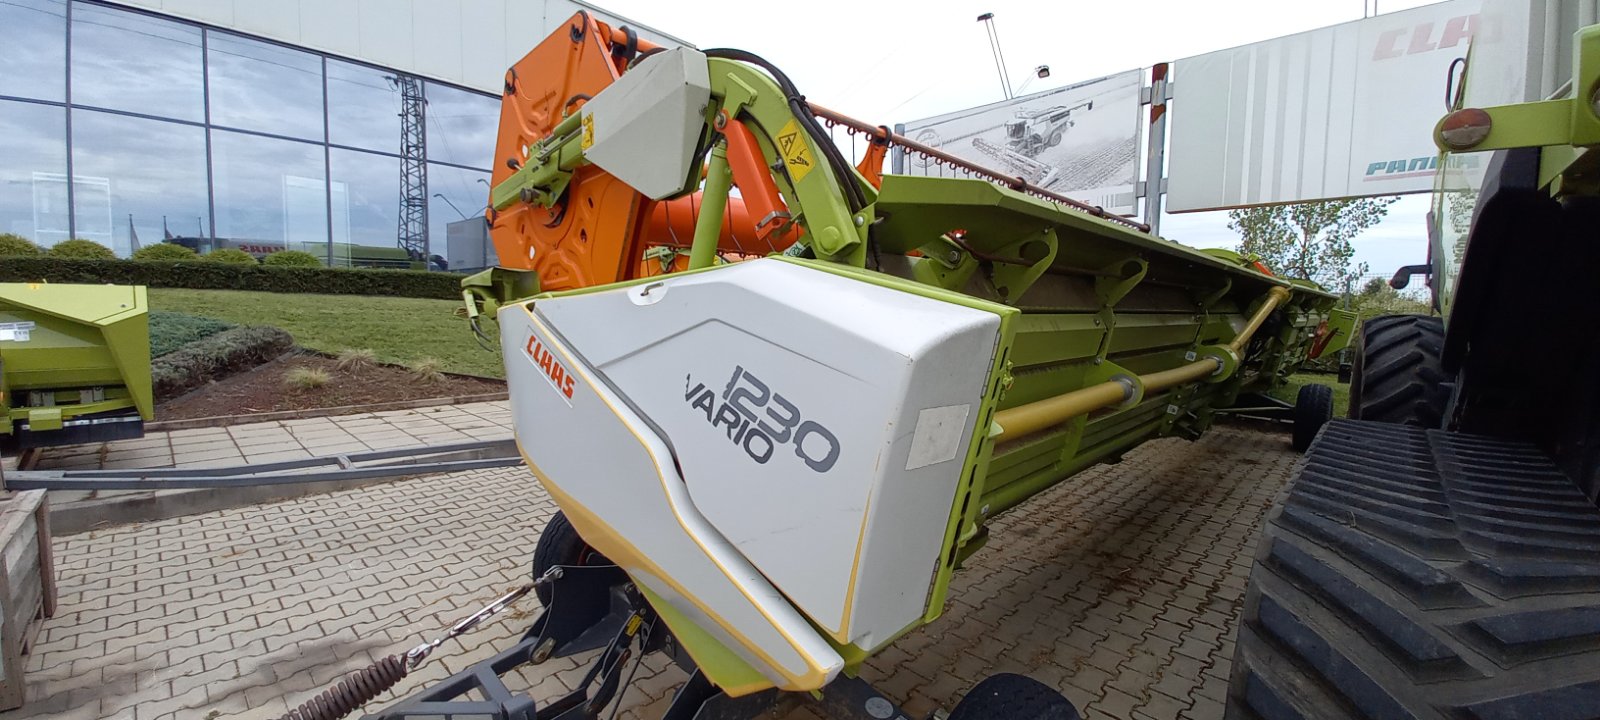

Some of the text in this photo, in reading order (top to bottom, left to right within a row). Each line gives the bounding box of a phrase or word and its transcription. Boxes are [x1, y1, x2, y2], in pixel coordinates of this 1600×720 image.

[1372, 13, 1482, 61] CLA
[526, 334, 576, 400] CLAAS
[685, 373, 774, 465] VARIO
[722, 365, 841, 473] 1230
